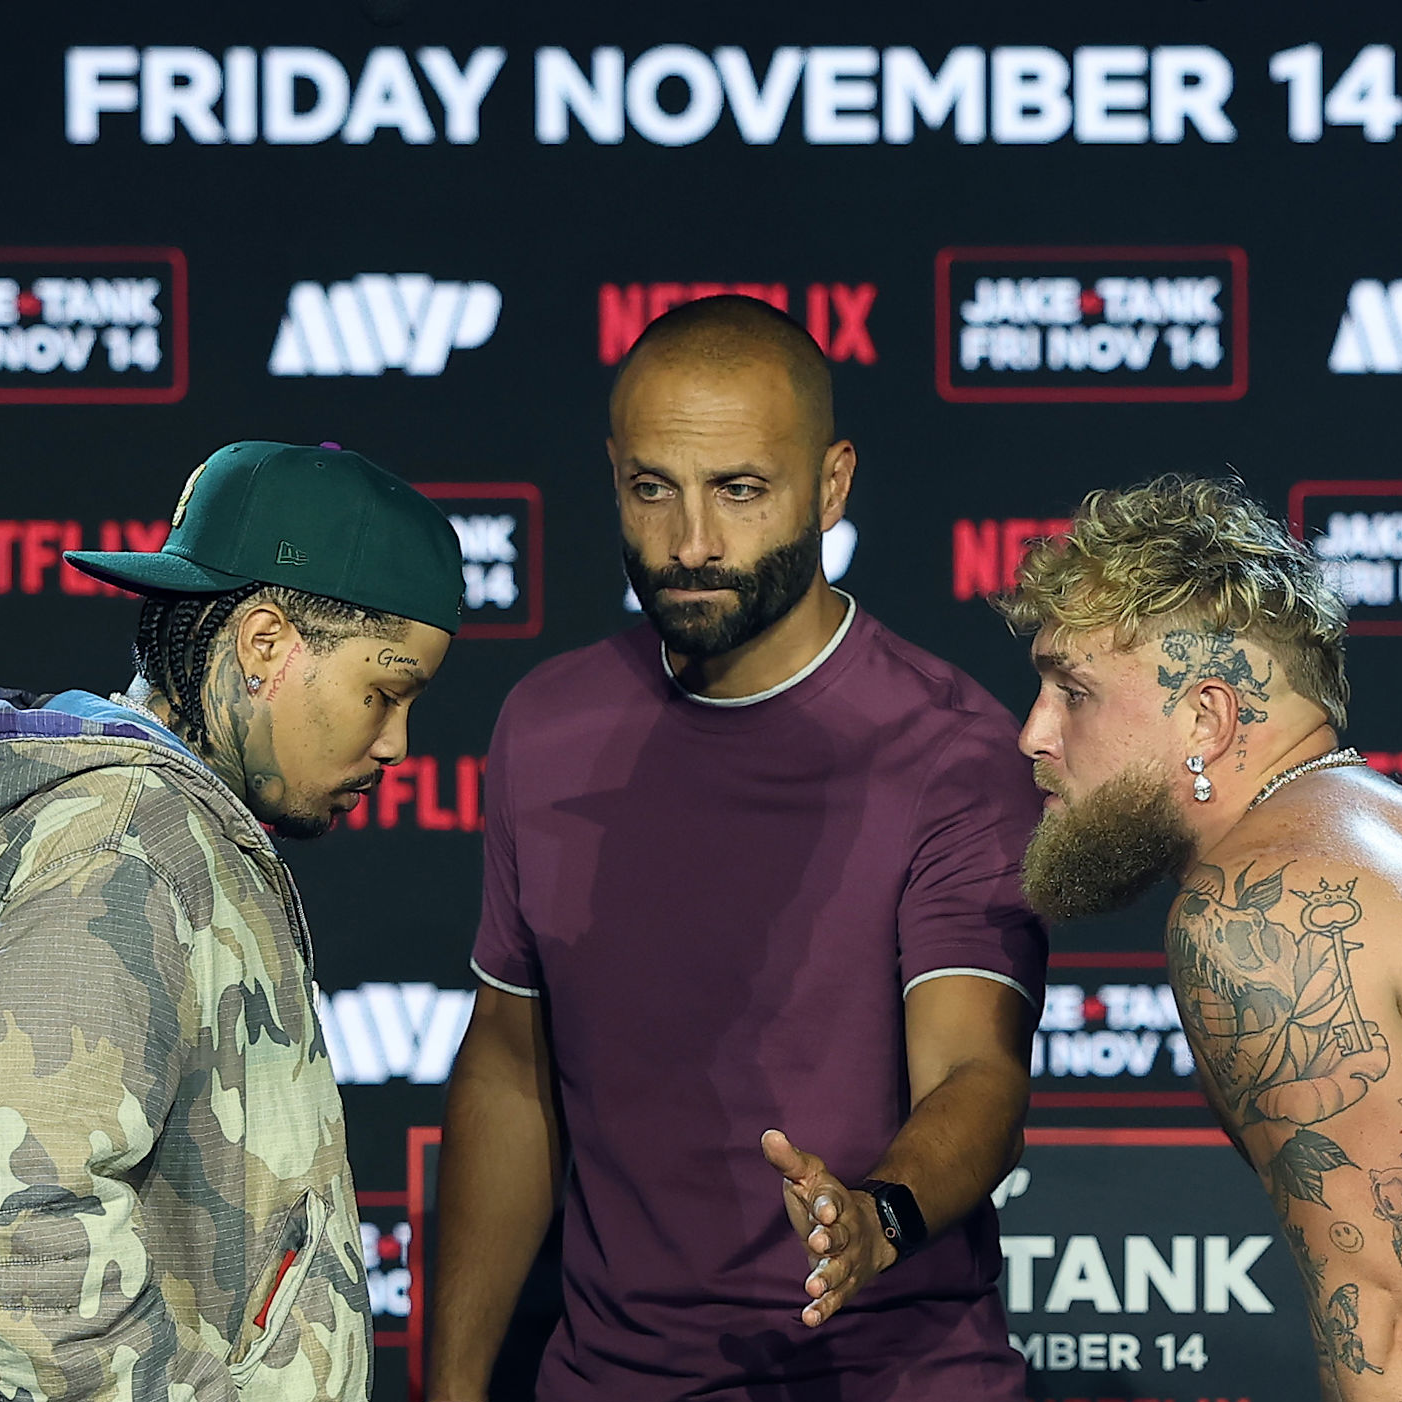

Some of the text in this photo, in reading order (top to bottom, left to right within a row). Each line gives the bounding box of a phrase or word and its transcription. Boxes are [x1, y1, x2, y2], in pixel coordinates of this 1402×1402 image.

[66, 47, 504, 144] FRIDAY
[536, 46, 1234, 145] NOVEMBER
[38, 279, 159, 325] TANK
[961, 278, 1220, 323] JAKE TANK
[105, 326, 160, 371] 14
[961, 325, 1220, 370] FRI NOV 14
[1050, 1033, 1159, 1076] NOV
[1001, 1235, 1275, 1314] TANK
[1154, 1333, 1209, 1372] 14
